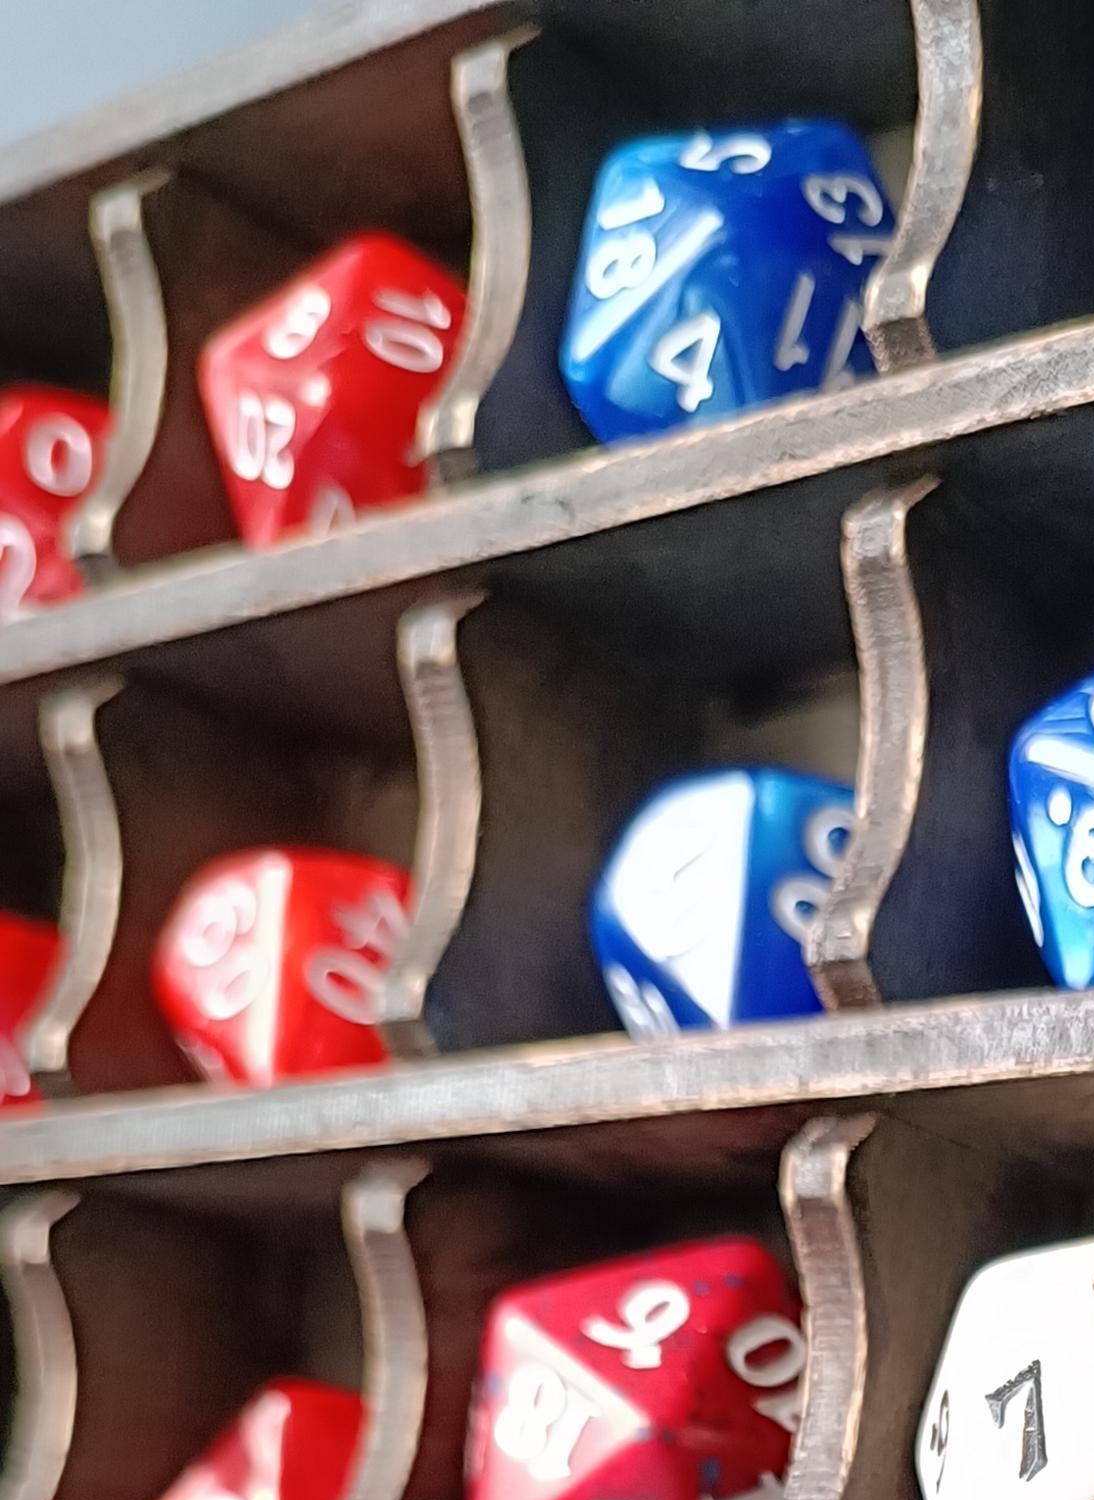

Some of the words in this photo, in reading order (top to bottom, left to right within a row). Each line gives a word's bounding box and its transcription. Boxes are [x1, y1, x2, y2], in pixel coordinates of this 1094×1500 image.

[586, 176, 666, 299] 18
[649, 310, 721, 412] 4
[984, 1359, 1048, 1483] 7
